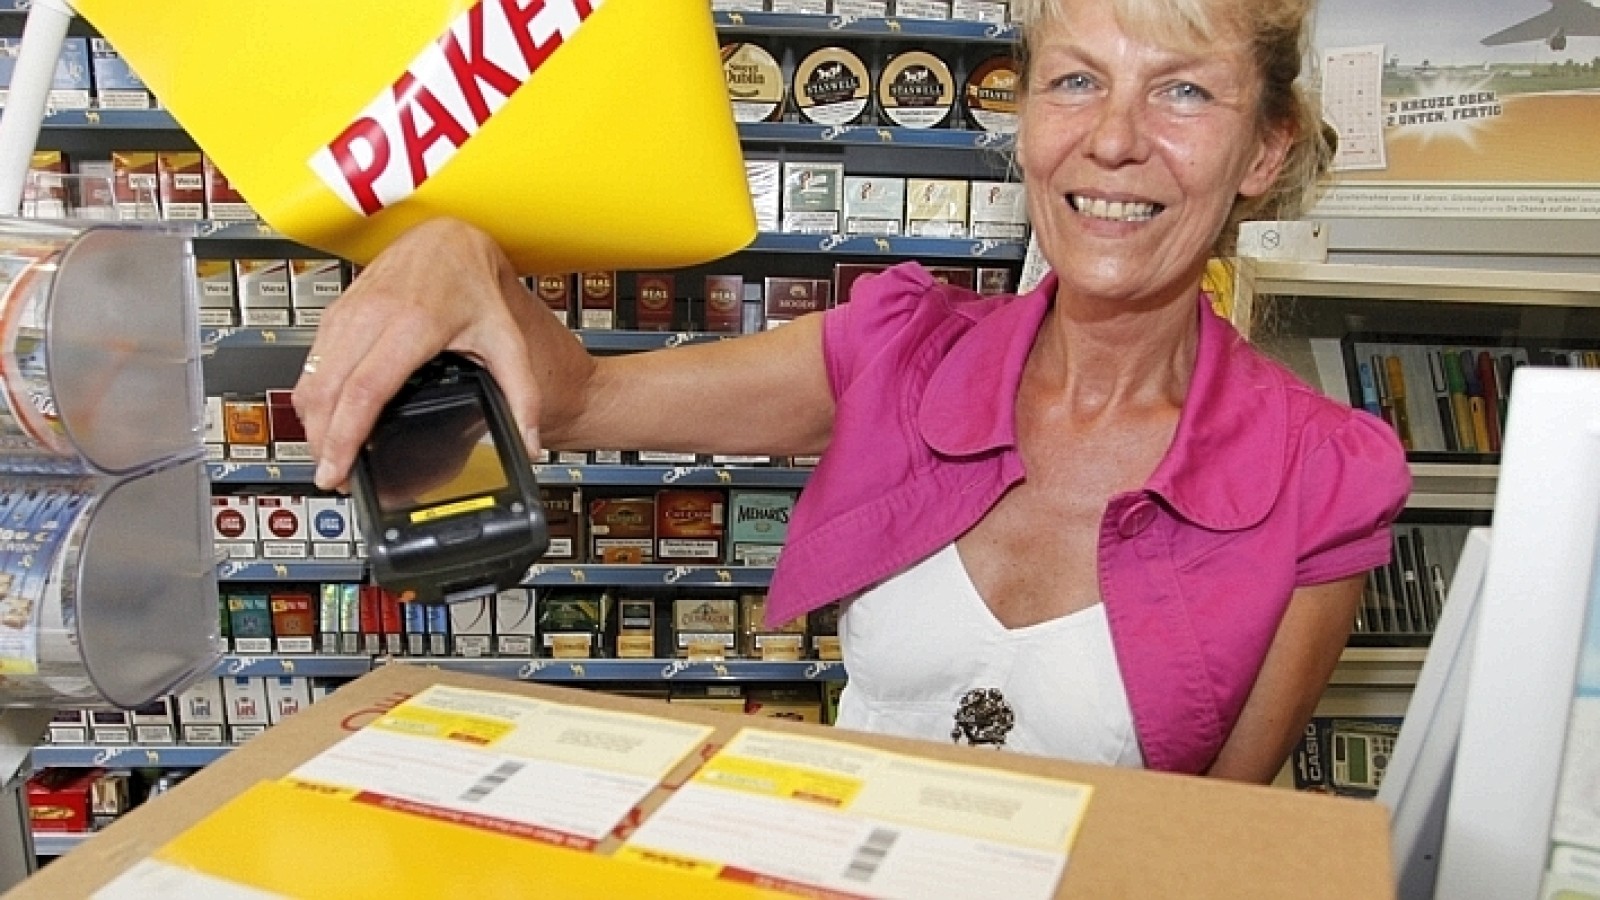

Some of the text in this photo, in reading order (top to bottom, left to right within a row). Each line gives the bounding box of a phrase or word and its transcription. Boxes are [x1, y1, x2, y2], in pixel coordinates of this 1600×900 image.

[328, 0, 593, 216] PAKE
[1387, 116, 1396, 127] 2
[1401, 96, 1454, 111] KREUZE
[1305, 723, 1321, 782] CASIO
